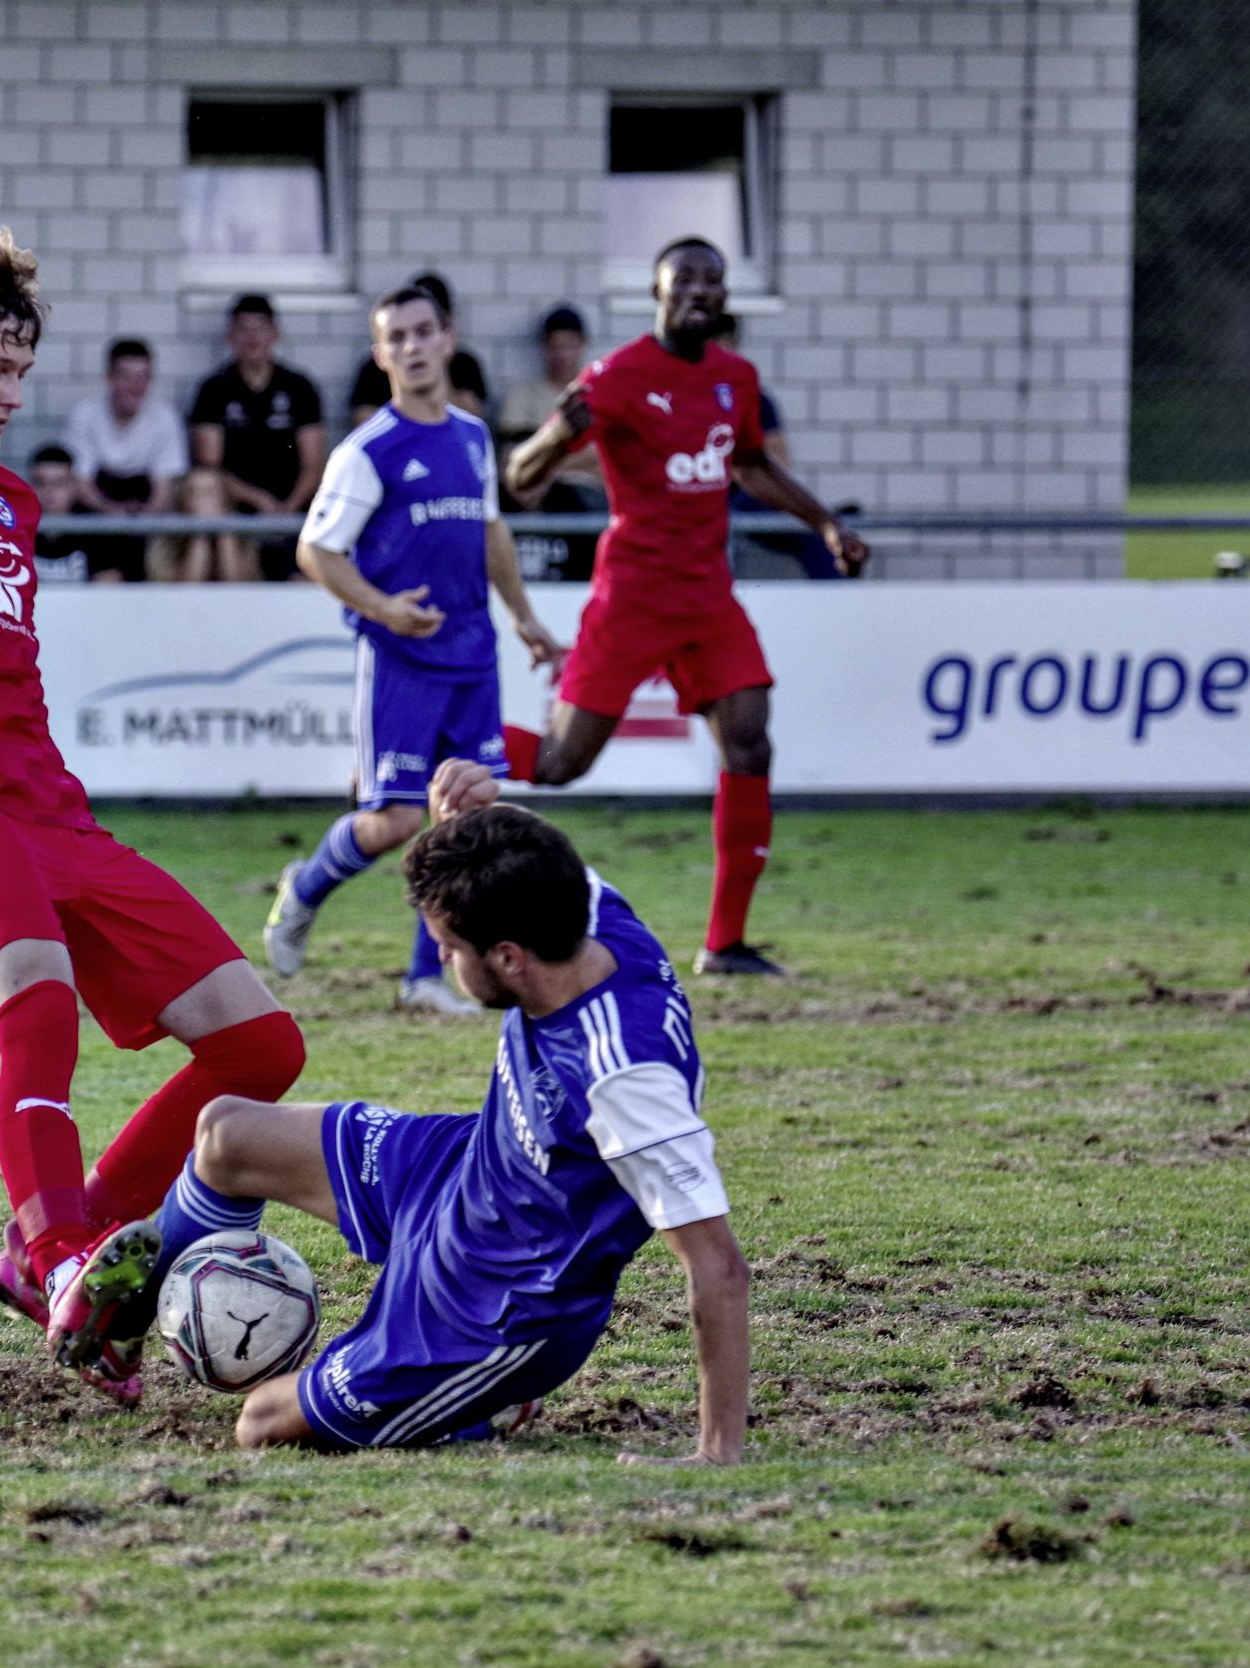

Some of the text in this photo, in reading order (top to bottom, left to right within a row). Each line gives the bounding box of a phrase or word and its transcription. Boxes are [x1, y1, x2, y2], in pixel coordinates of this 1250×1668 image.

[77, 699, 354, 747] E. MATTMÜLL
[924, 653, 1250, 743] groupe
[360, 1127, 377, 1184] LA ROCHE
